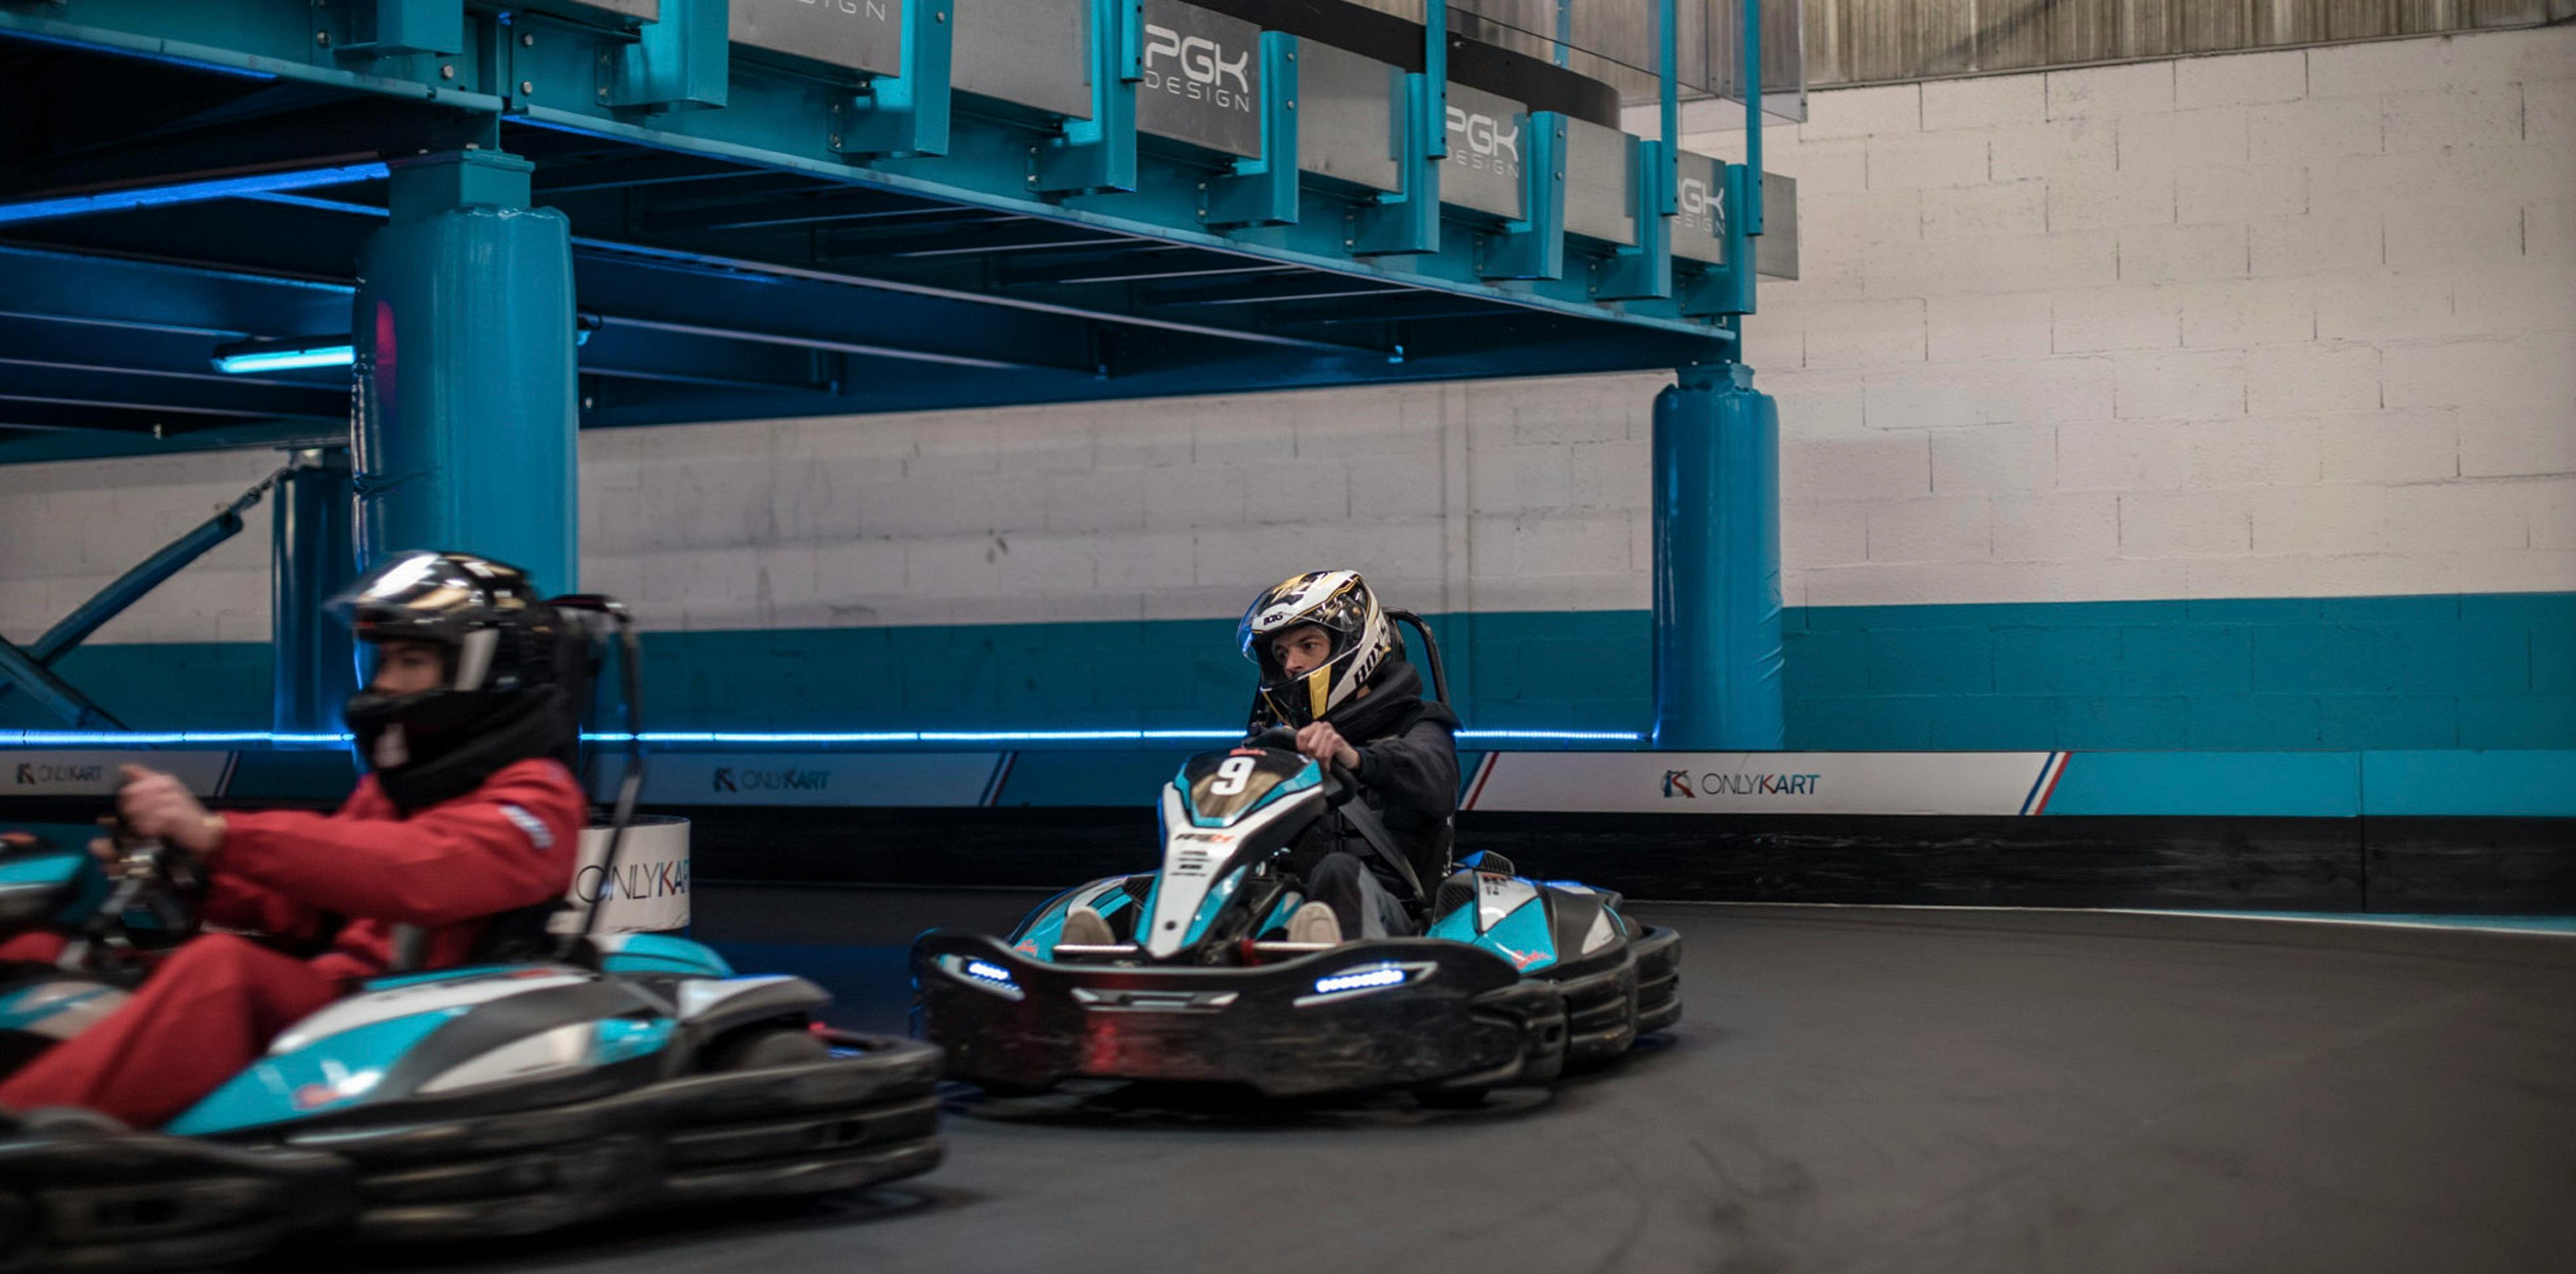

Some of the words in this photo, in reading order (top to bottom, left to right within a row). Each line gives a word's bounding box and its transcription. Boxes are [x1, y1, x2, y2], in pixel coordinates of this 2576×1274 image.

[1145, 24, 1248, 94] PGK
[1145, 70, 1250, 113] DESIGN
[1677, 177, 1725, 220] GK
[1210, 756, 1256, 796] 9
[1702, 773, 1820, 794] ONLYKART
